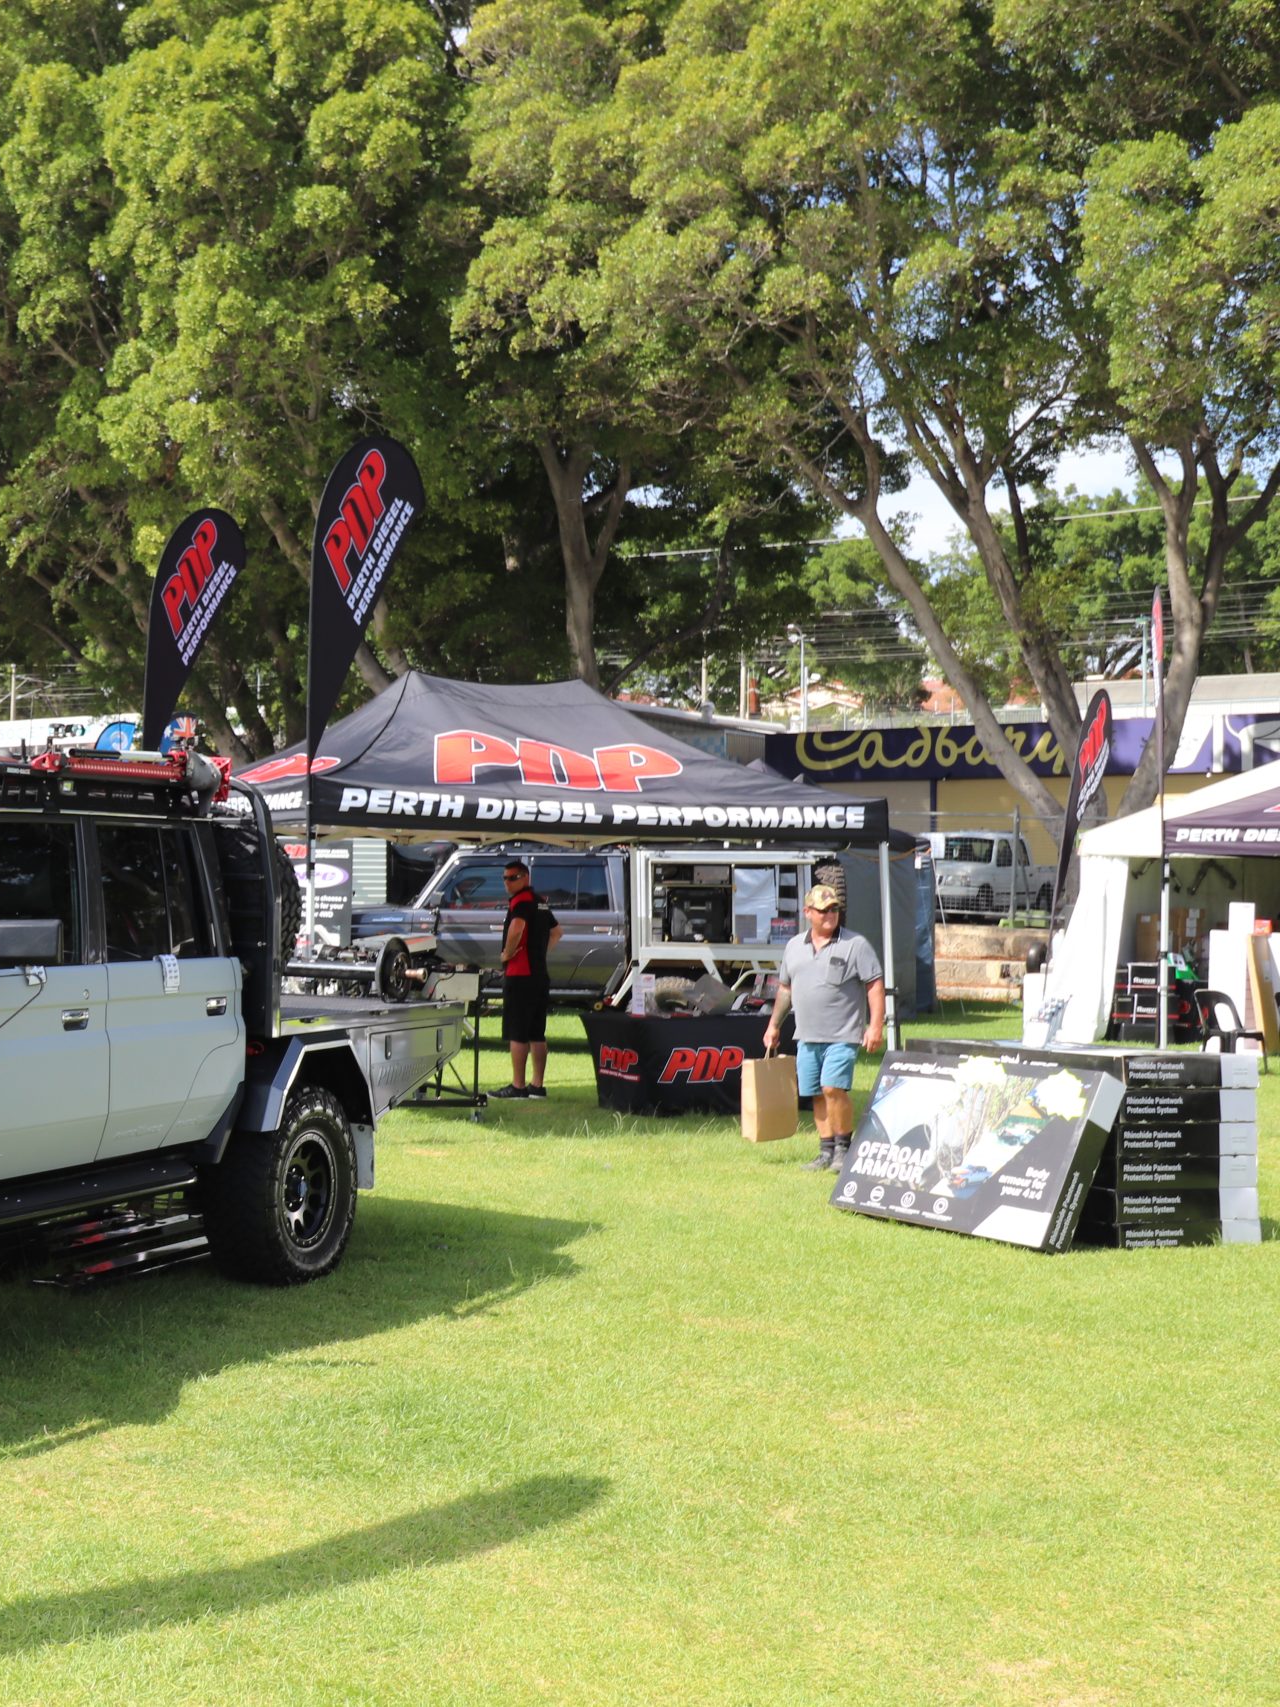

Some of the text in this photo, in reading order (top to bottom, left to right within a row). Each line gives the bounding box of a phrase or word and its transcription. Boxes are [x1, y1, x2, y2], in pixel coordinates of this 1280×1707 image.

[322, 449, 387, 597] PDP
[346, 497, 404, 610] PERTH DIESEL
[353, 501, 414, 626] PERFORMANCE
[161, 518, 218, 641] PDP
[177, 560, 230, 653] PERTH DIESEL
[181, 564, 238, 667] PERFORMANCE
[796, 725, 1065, 775] Cadbury
[434, 729, 683, 793] PDP
[338, 787, 866, 829] PERTH DIESEL PERFORMANCE
[1175, 827, 1241, 843] PERTH
[657, 1046, 745, 1084] PDP
[1128, 1061, 1185, 1071] Rhinohide Paintwork
[1128, 1071, 1180, 1082] Protection System
[1126, 1096, 1183, 1105] Rhinohide Paintwork
[1126, 1105, 1178, 1116] Protection System
[1123, 1130, 1182, 1140] Rhinohide Paintwork
[1123, 1139, 1176, 1150] Protection System
[857, 1141, 931, 1167] OFFROAD
[850, 1157, 924, 1184] ARMOUR
[1025, 1166, 1051, 1182] Body
[1123, 1163, 1182, 1173] Rhinohide Paintwork
[1031, 1178, 1047, 1190] for
[1123, 1172, 1176, 1183] Protection System
[1000, 1185, 1043, 1200] your 4x4
[1123, 1195, 1181, 1205] Rhinohide Paintwork
[1123, 1205, 1176, 1215] Protection System
[1125, 1228, 1184, 1239] Rhinohide Paintwork
[1125, 1238, 1178, 1249] Protection System
